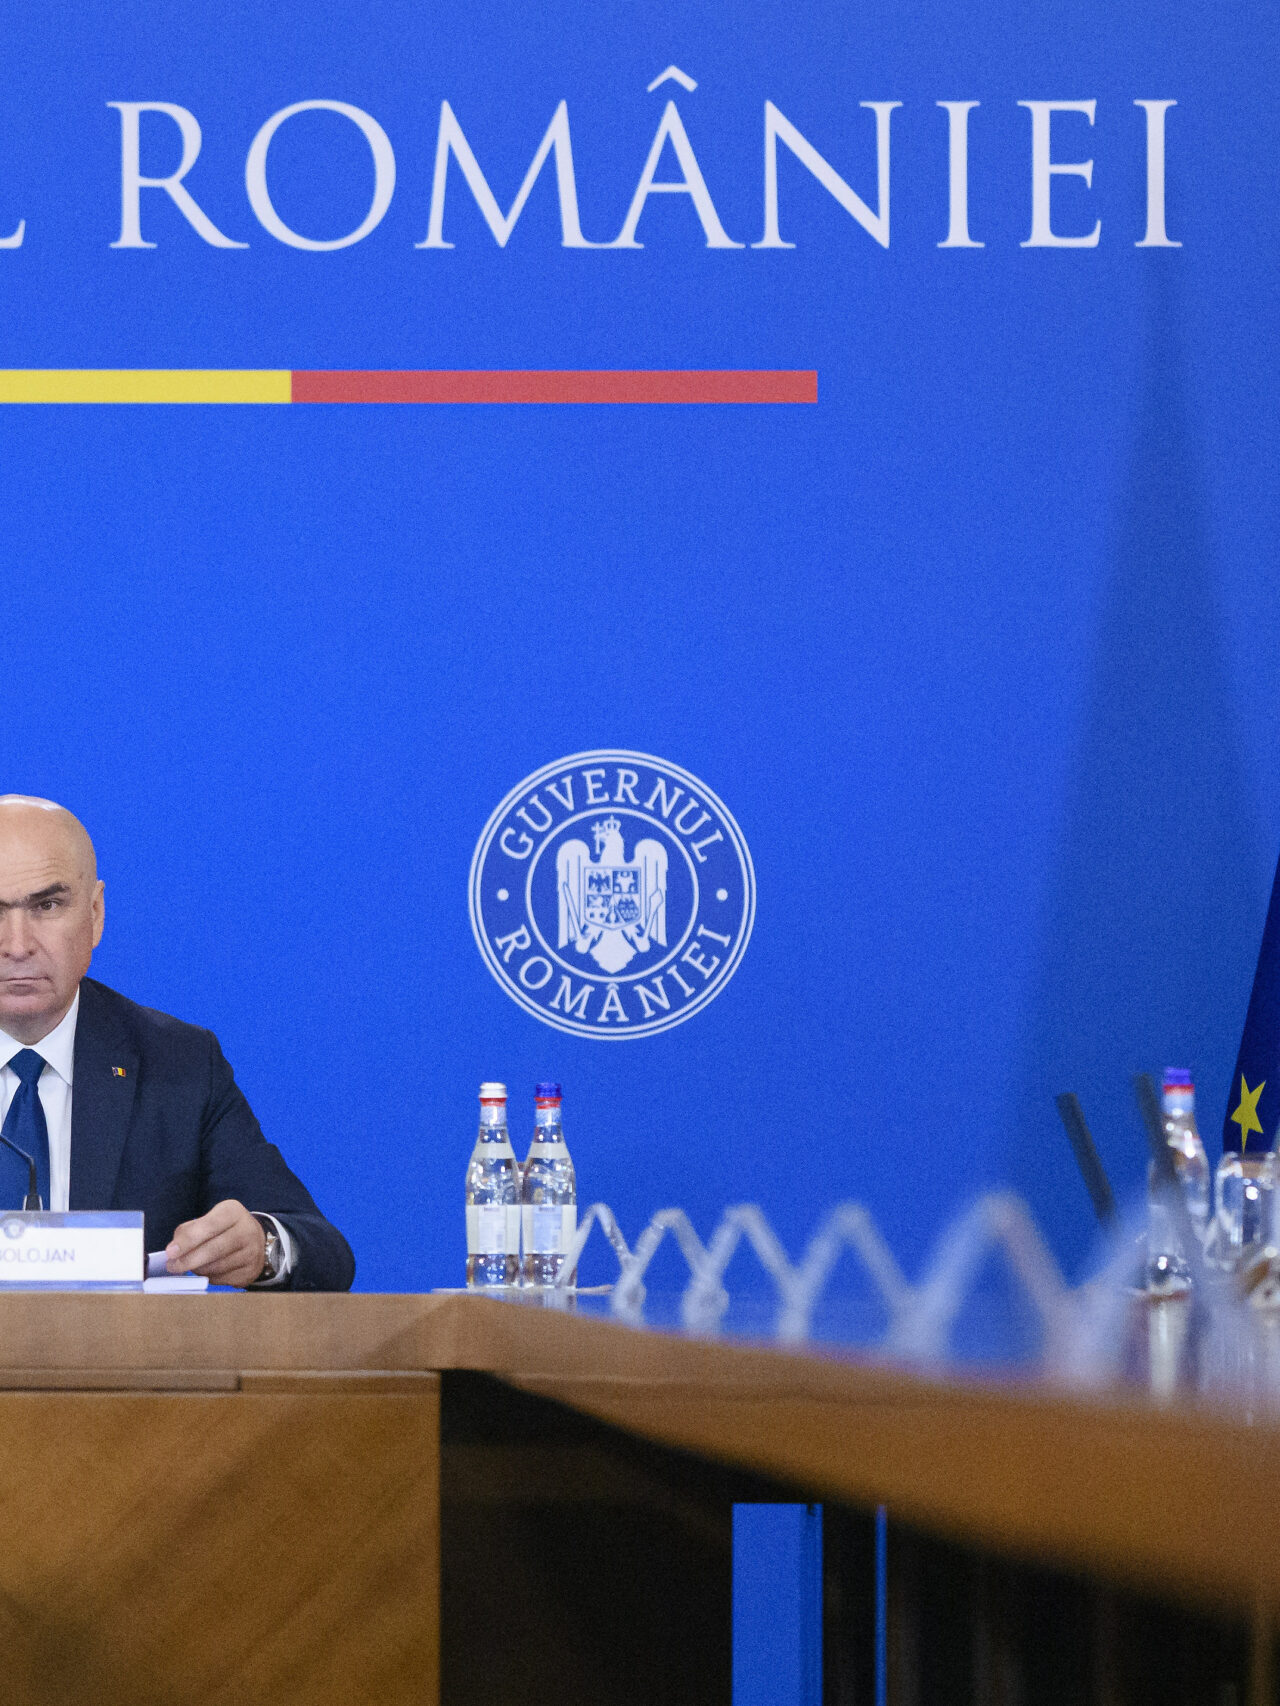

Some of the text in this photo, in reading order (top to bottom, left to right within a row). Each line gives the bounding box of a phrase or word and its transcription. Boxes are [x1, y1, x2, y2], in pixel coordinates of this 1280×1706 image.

[107, 65, 1182, 251] ROMÂNIEI
[499, 768, 724, 864] GUVERNUL
[495, 924, 731, 1023] ROMÂNIEI
